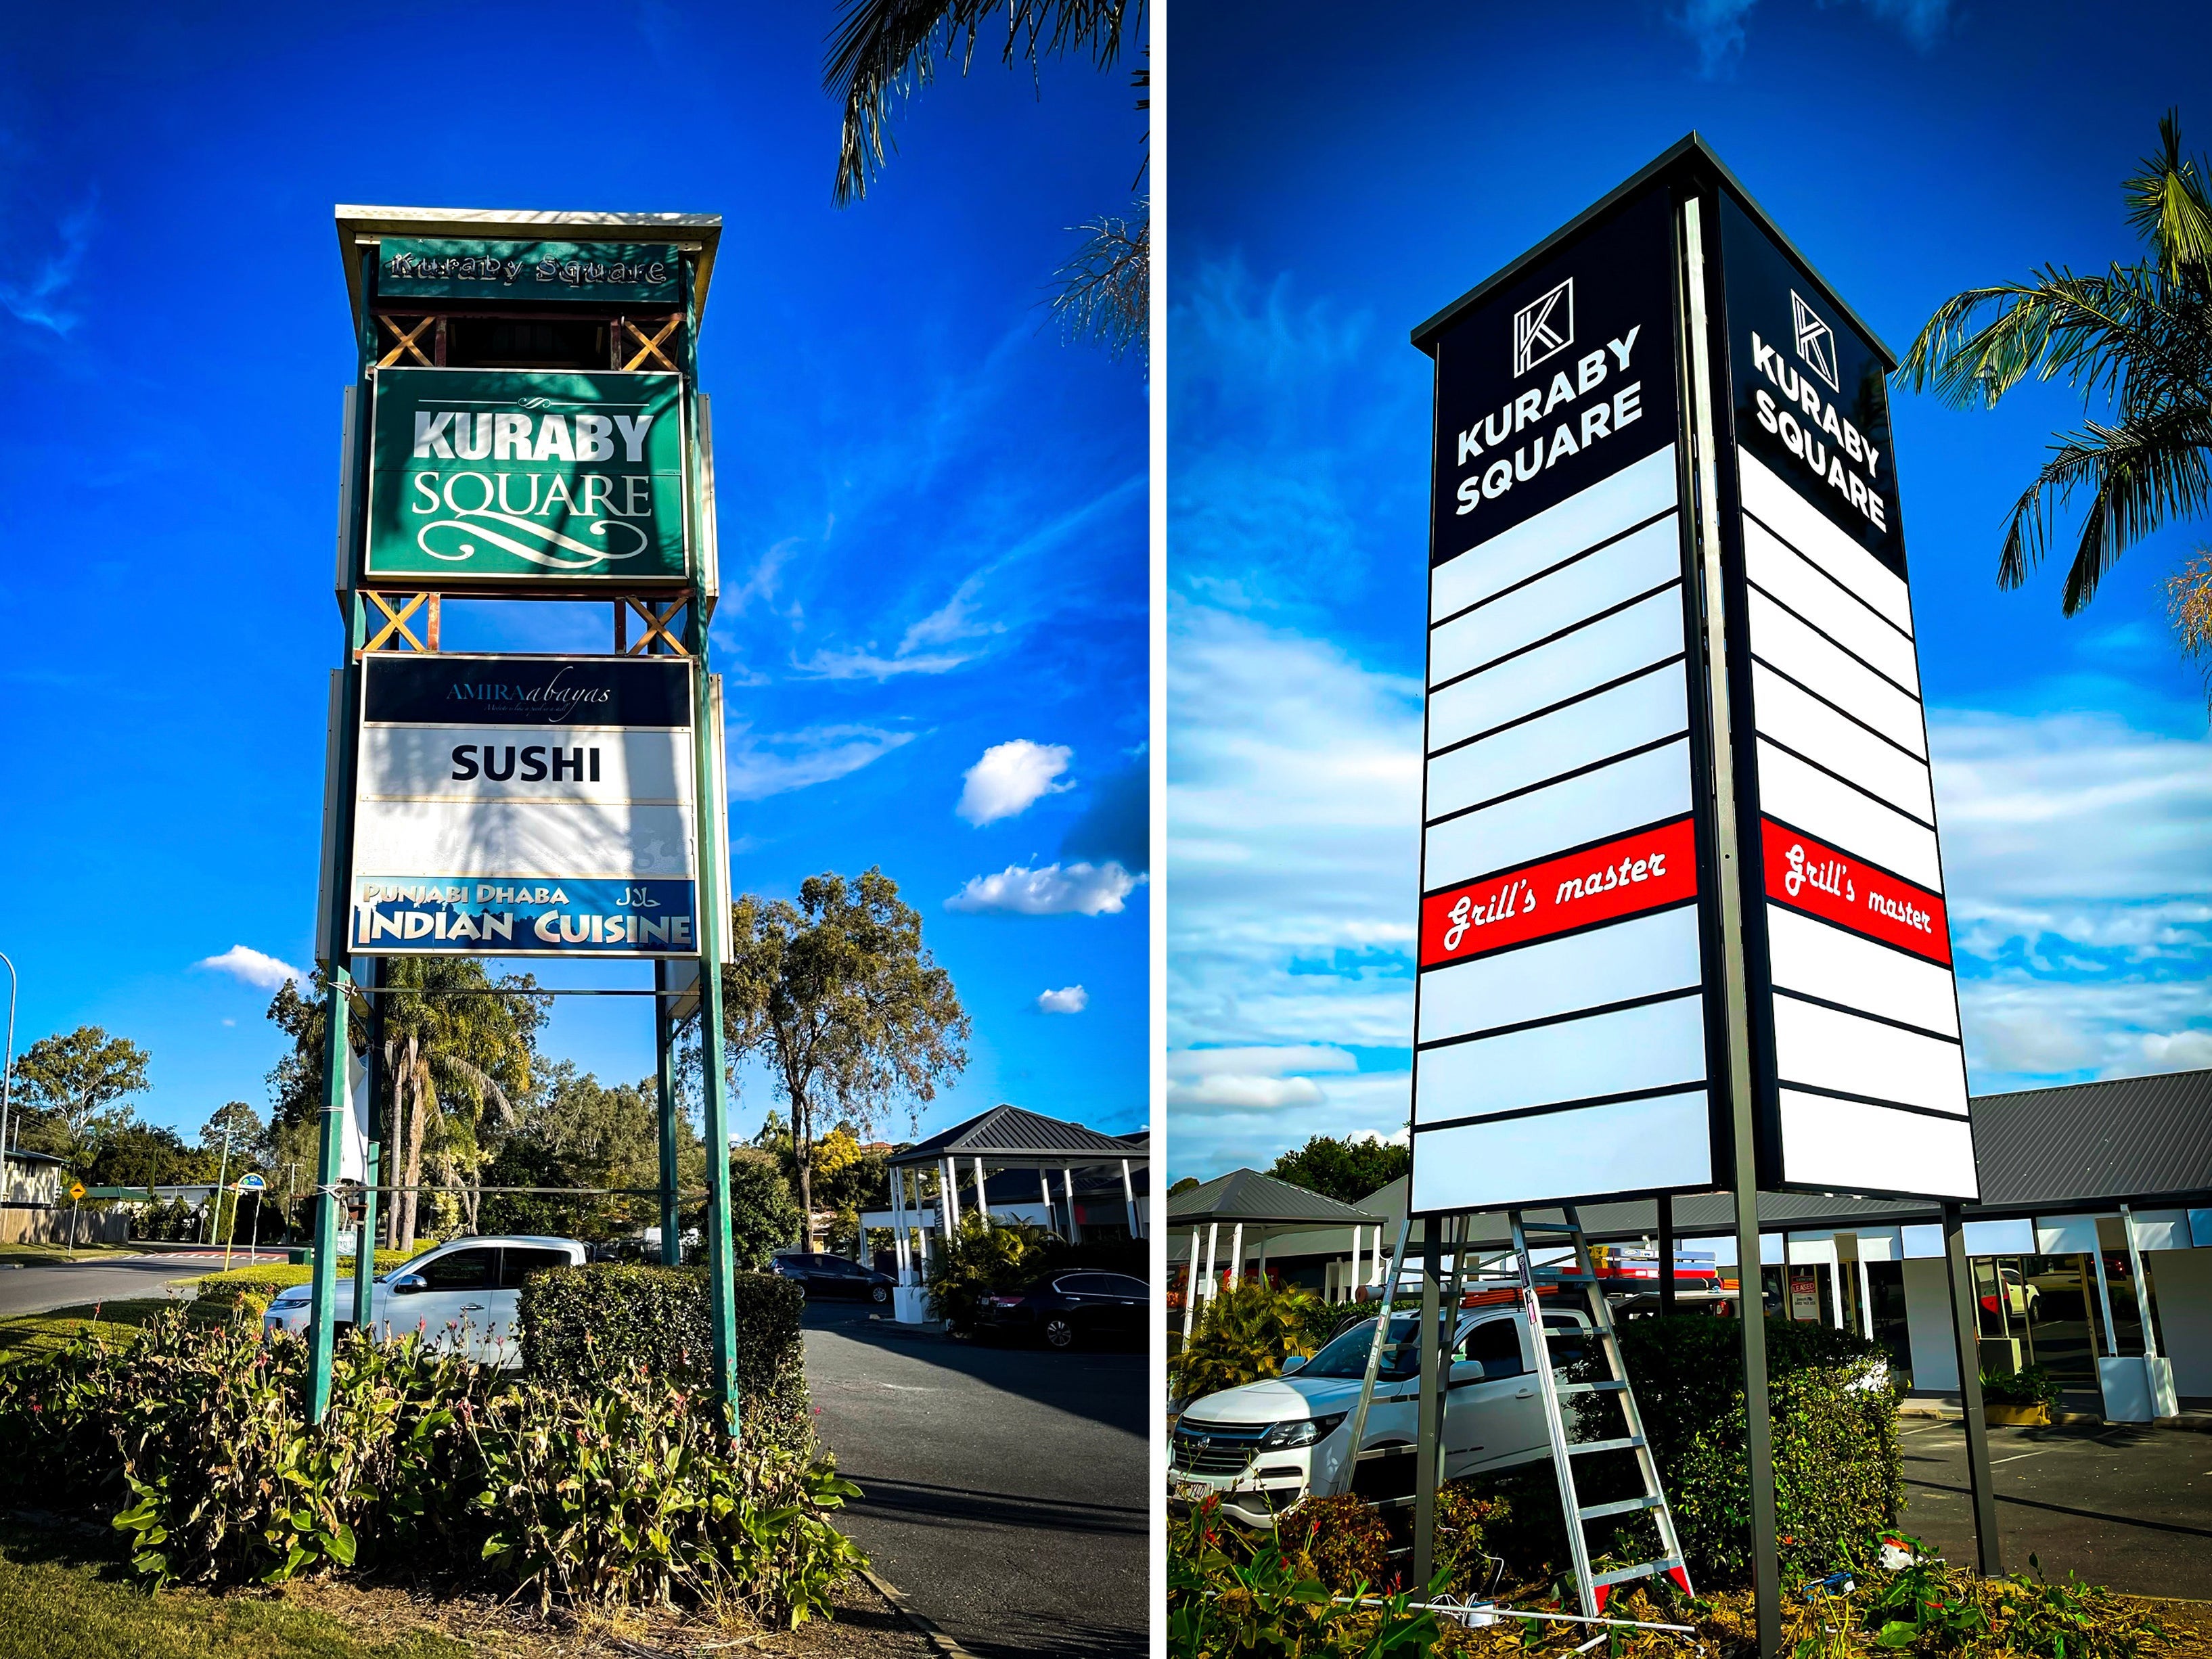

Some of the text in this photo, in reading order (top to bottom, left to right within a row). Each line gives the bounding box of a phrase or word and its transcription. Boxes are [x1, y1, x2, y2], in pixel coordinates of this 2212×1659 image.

[389, 252, 668, 288] Kuraby Square
[1458, 323, 1642, 467] KURABY
[1751, 330, 1878, 479] KURABY
[413, 411, 654, 462] KURABY
[1455, 380, 1643, 516] SQUARE
[1756, 389, 1887, 533] SQUARE
[411, 471, 652, 519] SQUARE
[451, 744, 600, 782] SUSHI
[363, 883, 569, 908] PUNJABI DHABA
[615, 887, 661, 908] حلال
[1443, 853, 1667, 951] Grill's master
[1784, 844, 1933, 934] Grill's master
[358, 904, 691, 945] INDIAN CUISINE
[1793, 1283, 1815, 1292] LEASED
